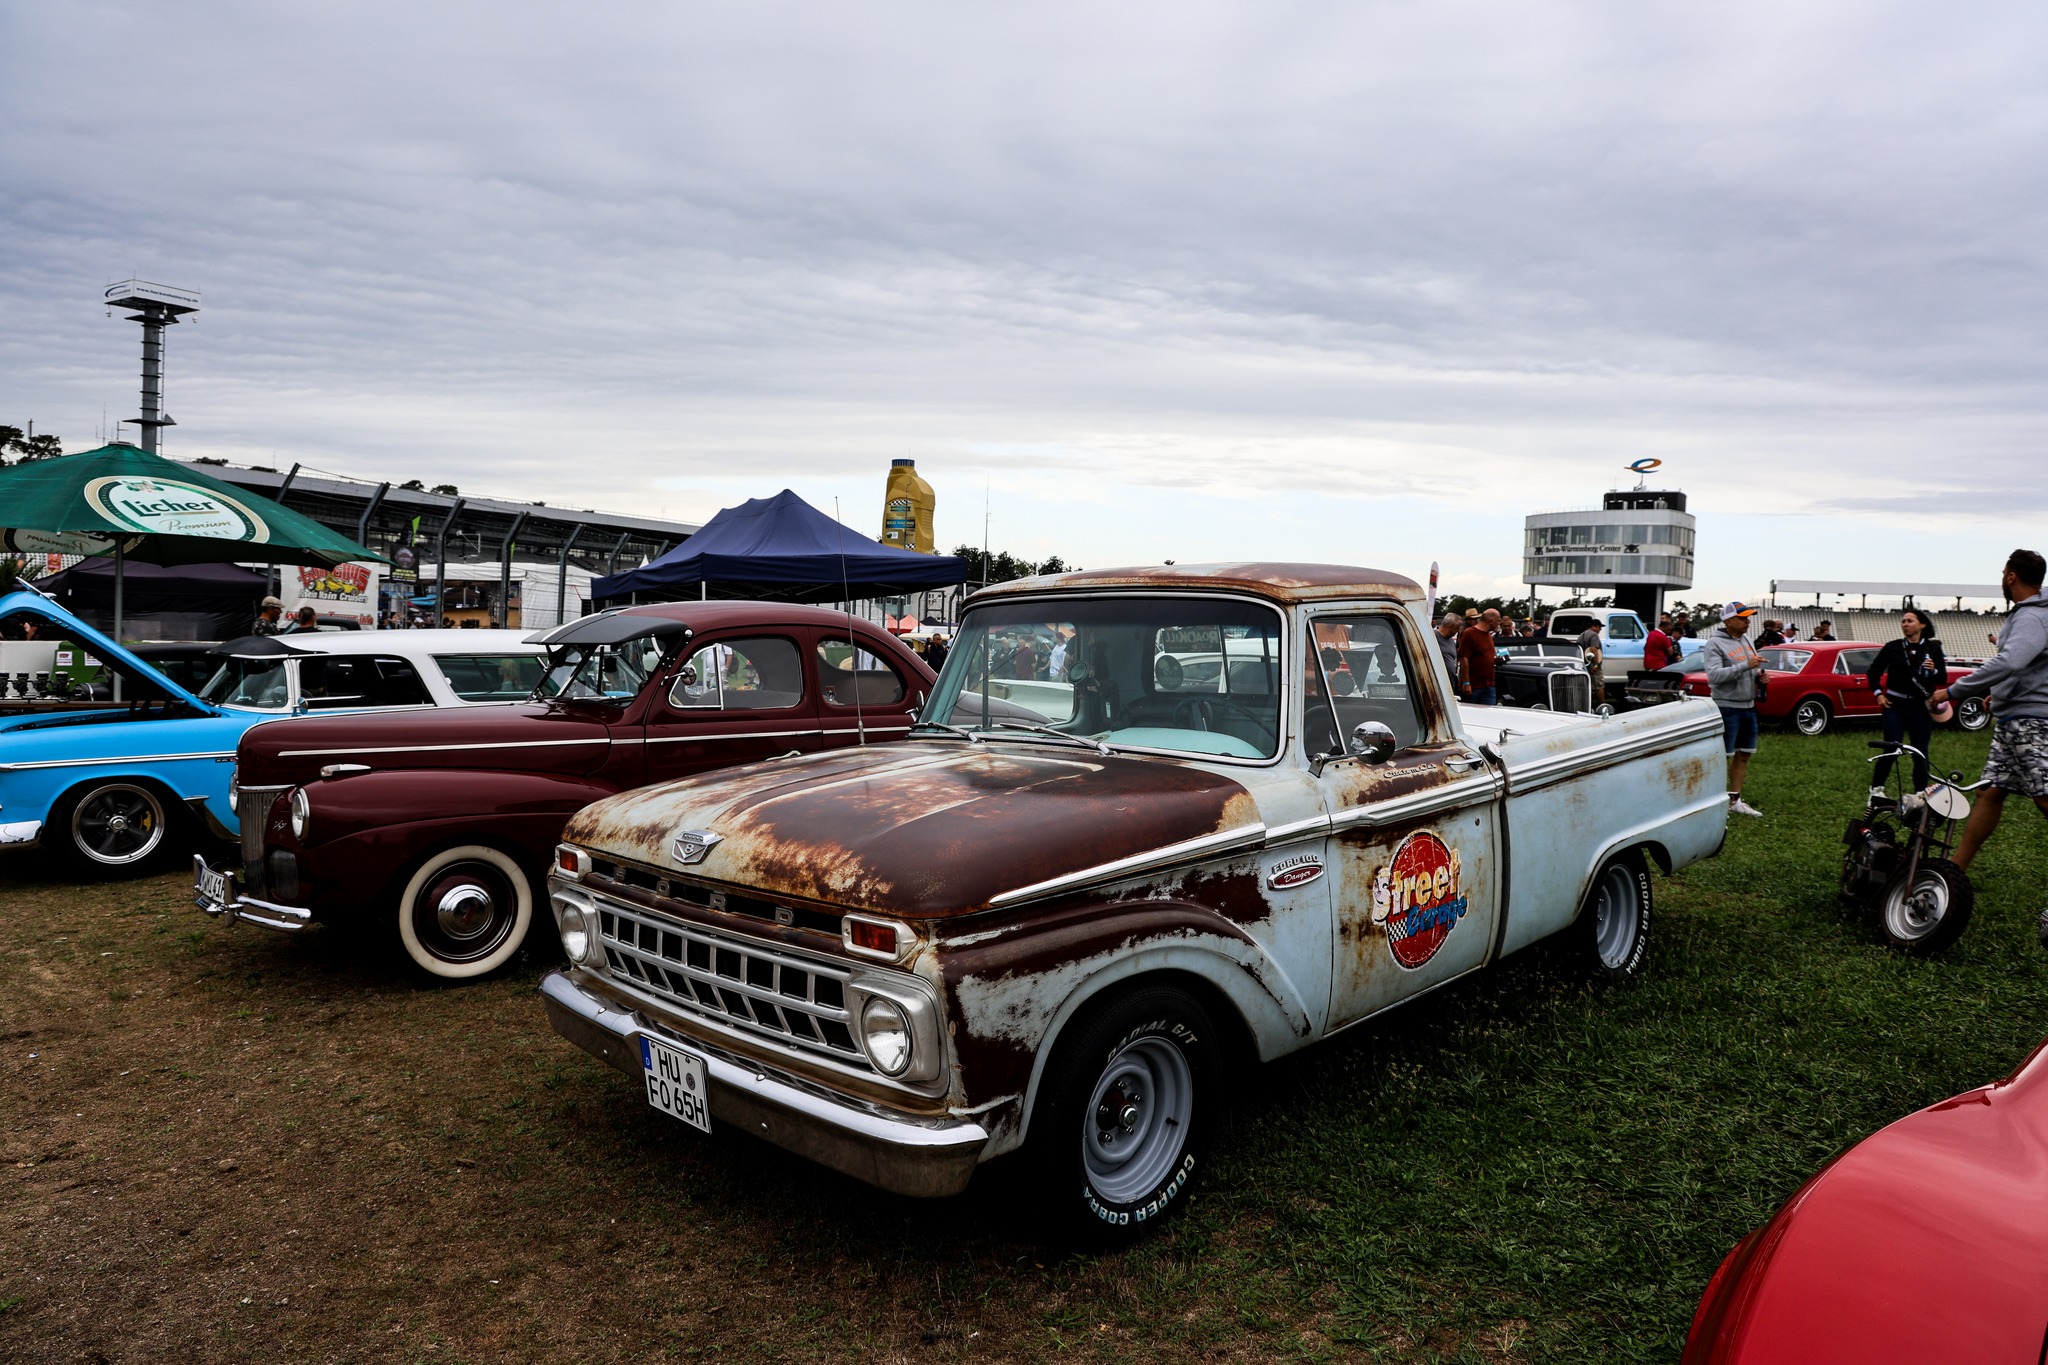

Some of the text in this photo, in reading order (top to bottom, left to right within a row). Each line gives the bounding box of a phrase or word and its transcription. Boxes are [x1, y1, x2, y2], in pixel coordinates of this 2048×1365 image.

[120, 498, 214, 517] Licher
[159, 519, 232, 531] Premium
[1545, 544, 1621, 554] Baden-Württemberg Center
[319, 591, 337, 600] Main
[340, 593, 368, 603] Cruisers
[1273, 854, 1319, 874] FORD 100
[1372, 848, 1461, 924] Street
[1638, 873, 1650, 931] COOPER
[1407, 894, 1469, 937] Garage
[1625, 935, 1646, 975] COBRA
[1108, 1019, 1198, 1063] RADIAL G/T
[657, 1048, 681, 1085] HU
[648, 1074, 707, 1128] FO 65H
[1083, 1185, 1129, 1226] COBRA
[1136, 1153, 1196, 1222] COOPER
